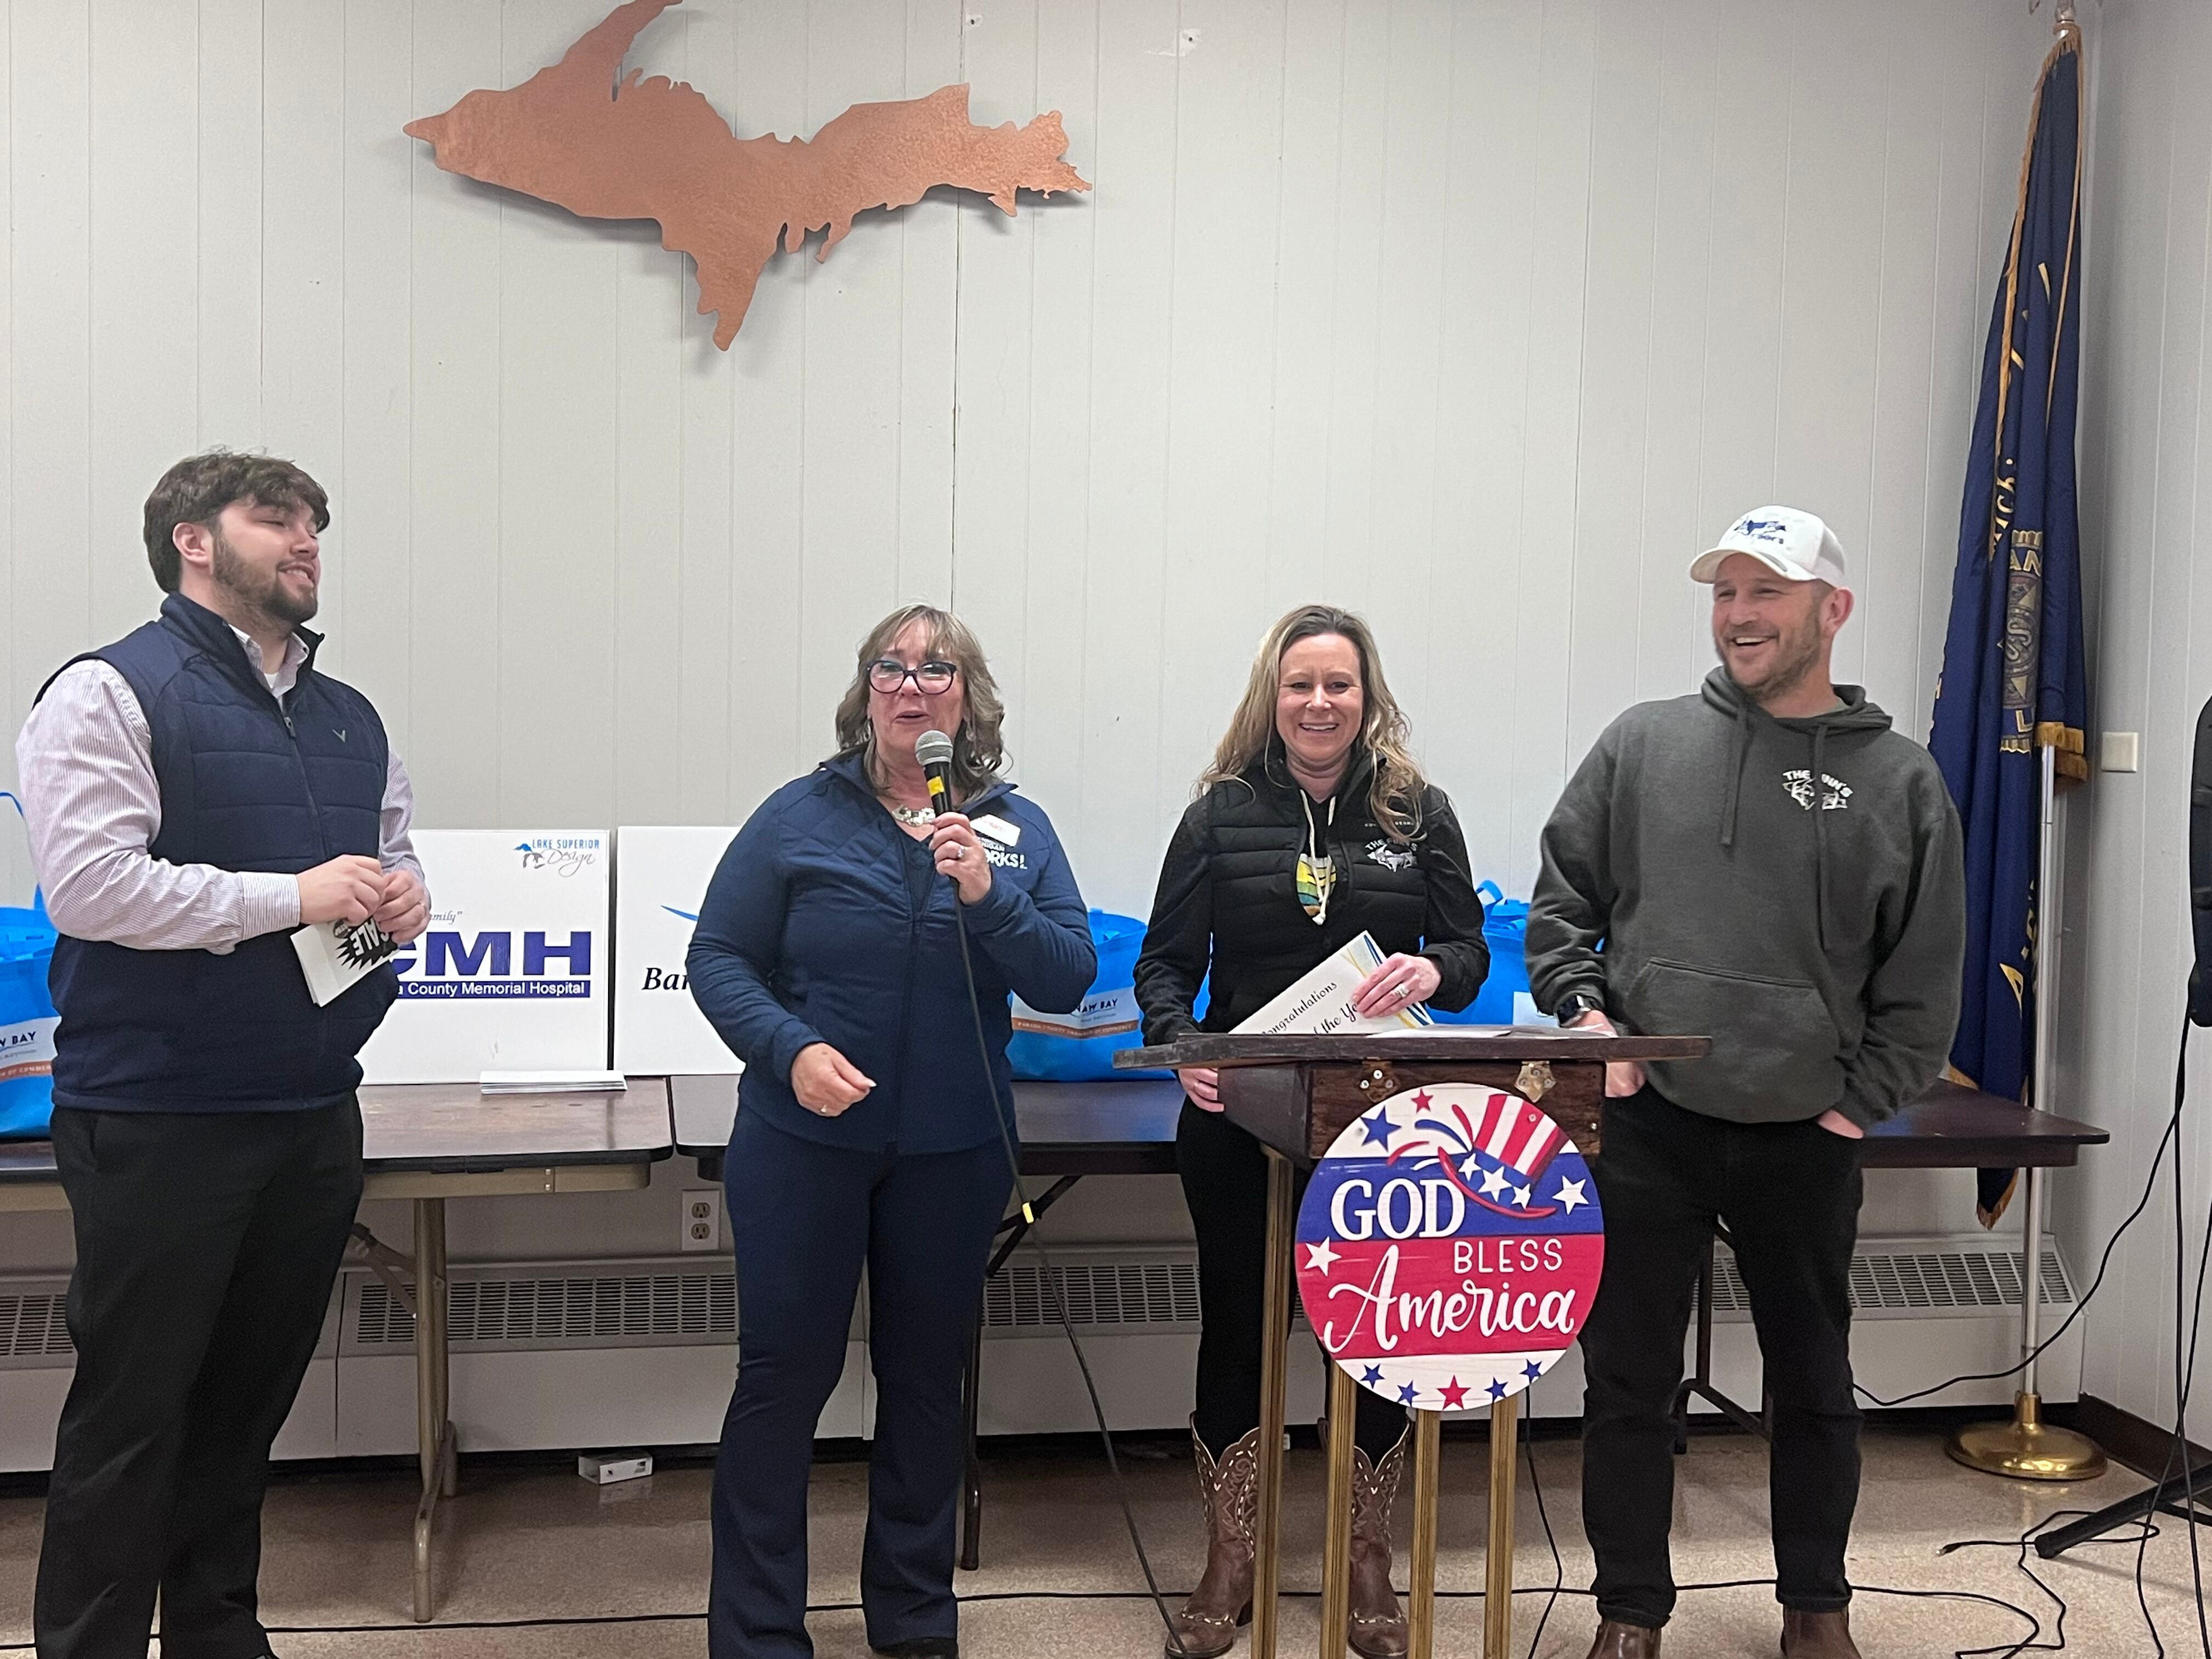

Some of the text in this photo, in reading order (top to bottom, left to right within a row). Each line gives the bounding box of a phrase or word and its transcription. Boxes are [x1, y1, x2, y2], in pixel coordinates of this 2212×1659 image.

[1782, 770, 1811, 781] THE
[532, 839, 600, 849] LAKE SUPERIOR
[1365, 839, 1386, 850] THE
[541, 848, 596, 877] Design
[408, 982, 457, 997] County
[462, 982, 525, 995] Memorial
[531, 982, 584, 996] Hospital
[1100, 999, 1118, 1009] BAY
[1321, 1018, 1341, 1034] the
[12, 1031, 36, 1045] BAY
[1331, 1178, 1466, 1241] GOD
[1454, 1238, 1562, 1274] BLESS
[1323, 1244, 1577, 1353] America
